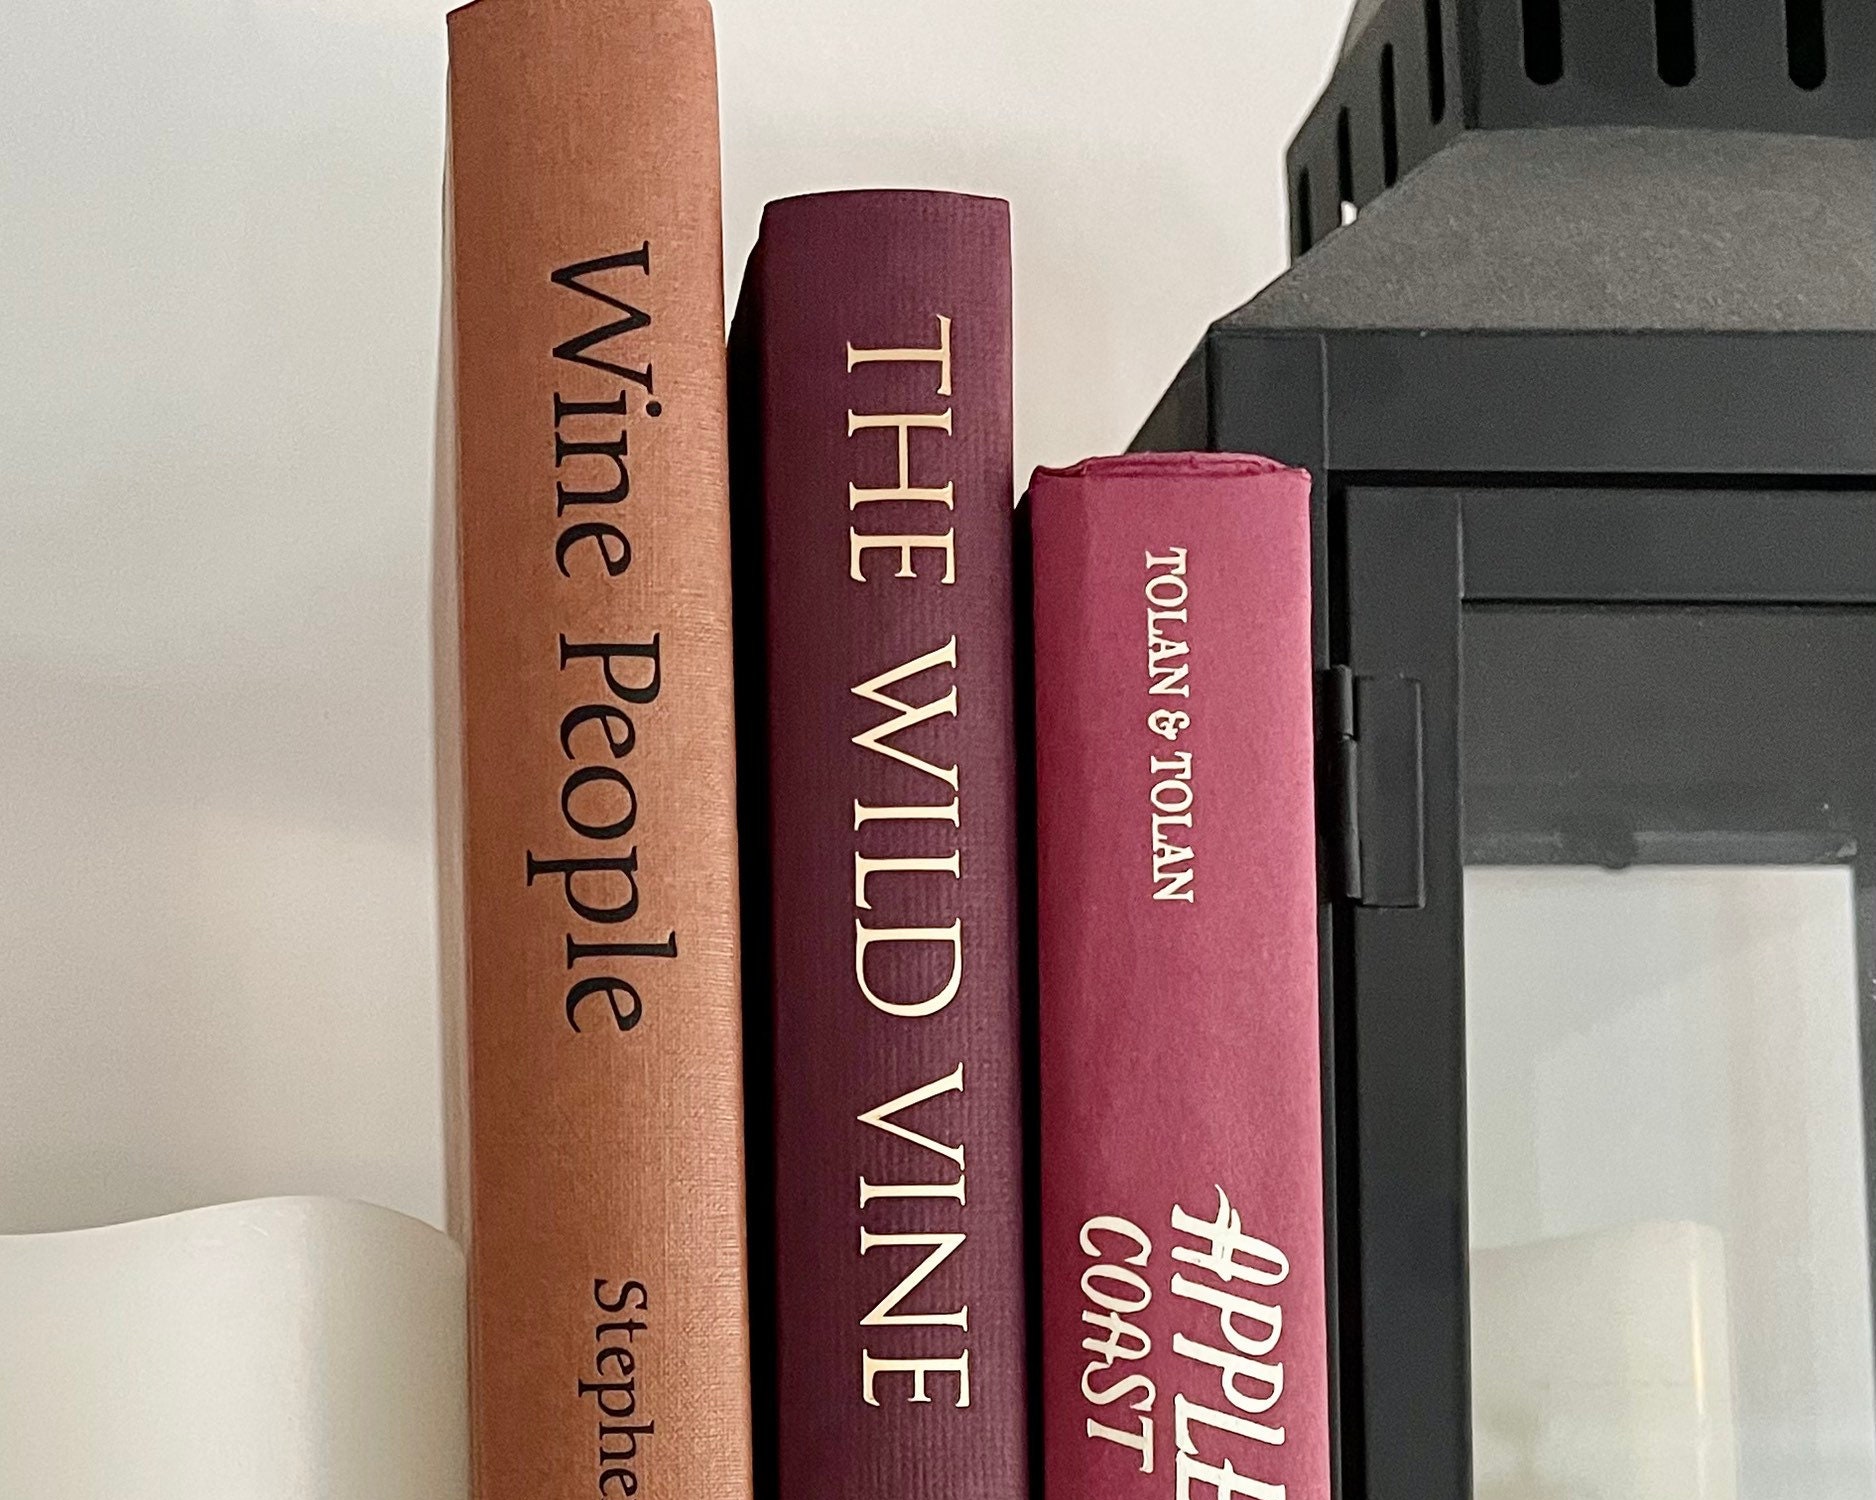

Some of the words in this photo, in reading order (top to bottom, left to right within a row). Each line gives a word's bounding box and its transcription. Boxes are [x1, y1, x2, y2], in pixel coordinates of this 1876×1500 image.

[550, 240, 663, 578] Wine
[846, 313, 956, 584] THE
[1145, 546, 1190, 698] TOLAN
[1147, 708, 1191, 741] &
[526, 632, 678, 1034] People
[850, 634, 962, 1017] WILD
[1150, 751, 1195, 904] TOLAN
[856, 1061, 970, 1408] VINE
[1079, 1215, 1157, 1474] COAST
